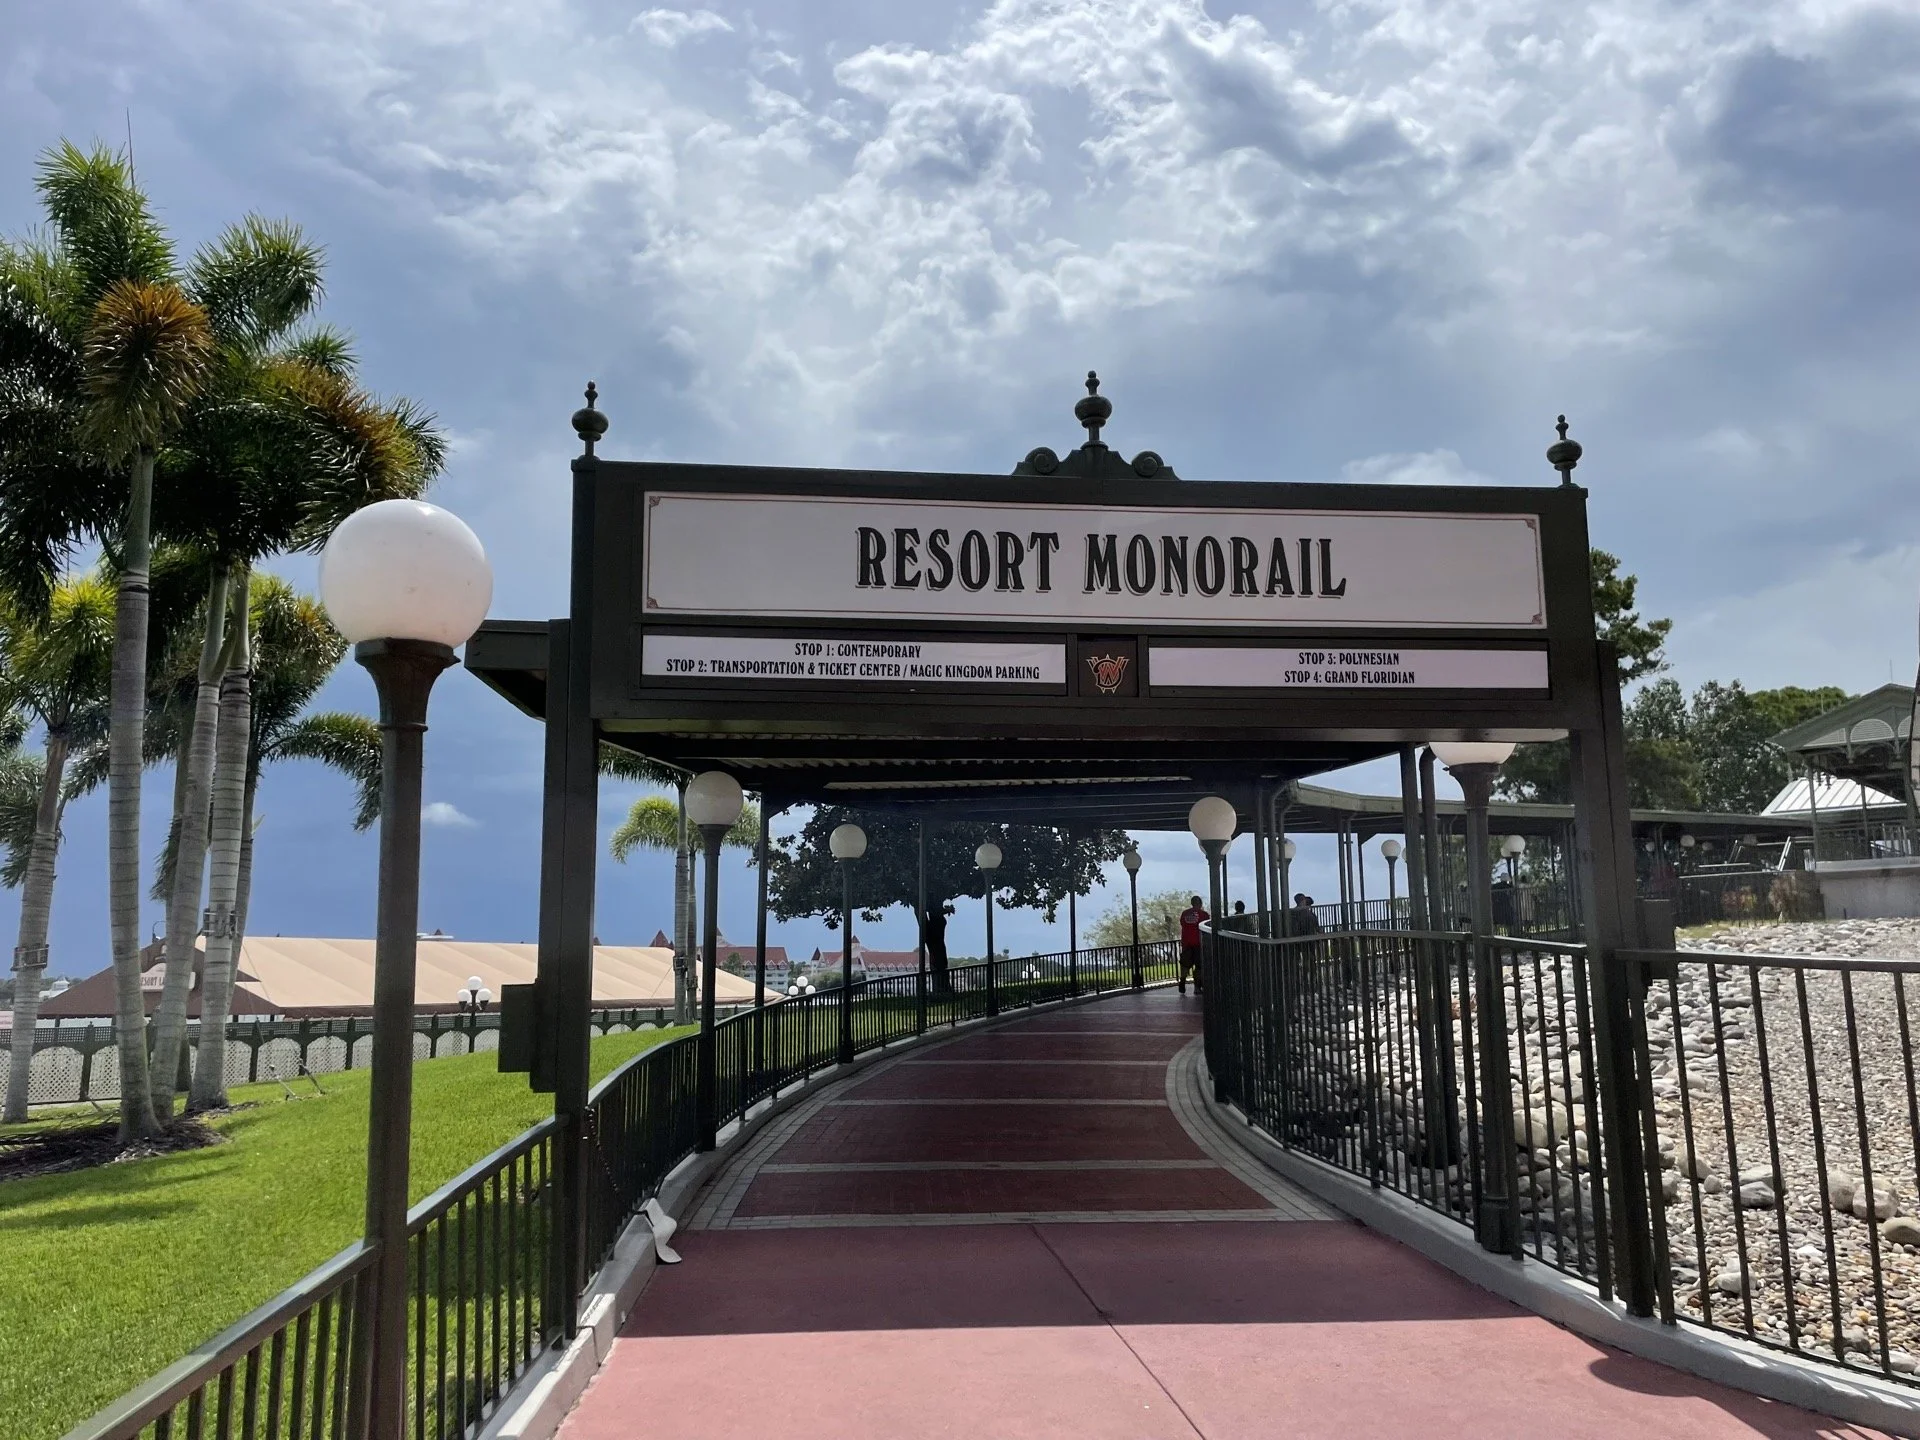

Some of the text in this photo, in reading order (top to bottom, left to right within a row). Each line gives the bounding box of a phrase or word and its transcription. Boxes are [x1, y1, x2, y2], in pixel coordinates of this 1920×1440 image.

[855, 527, 1347, 599] RESORT MONORAIL
[795, 642, 921, 658] STOP 1: CONTEMPORARY
[1298, 652, 1400, 665] STOP 3: POLYNESIAN
[666, 658, 695, 672] STOP
[698, 660, 707, 673] 2:
[711, 660, 804, 675] TRANSPORTATION
[807, 662, 815, 675] &
[818, 662, 857, 676] TICKET
[859, 663, 900, 677] CENTER
[910, 664, 942, 678] MAGIC
[945, 665, 993, 679] KINGDOM
[995, 666, 1040, 680] PARKING
[1284, 671, 1415, 684] STOP 4: GRAND FLORIDIAN
